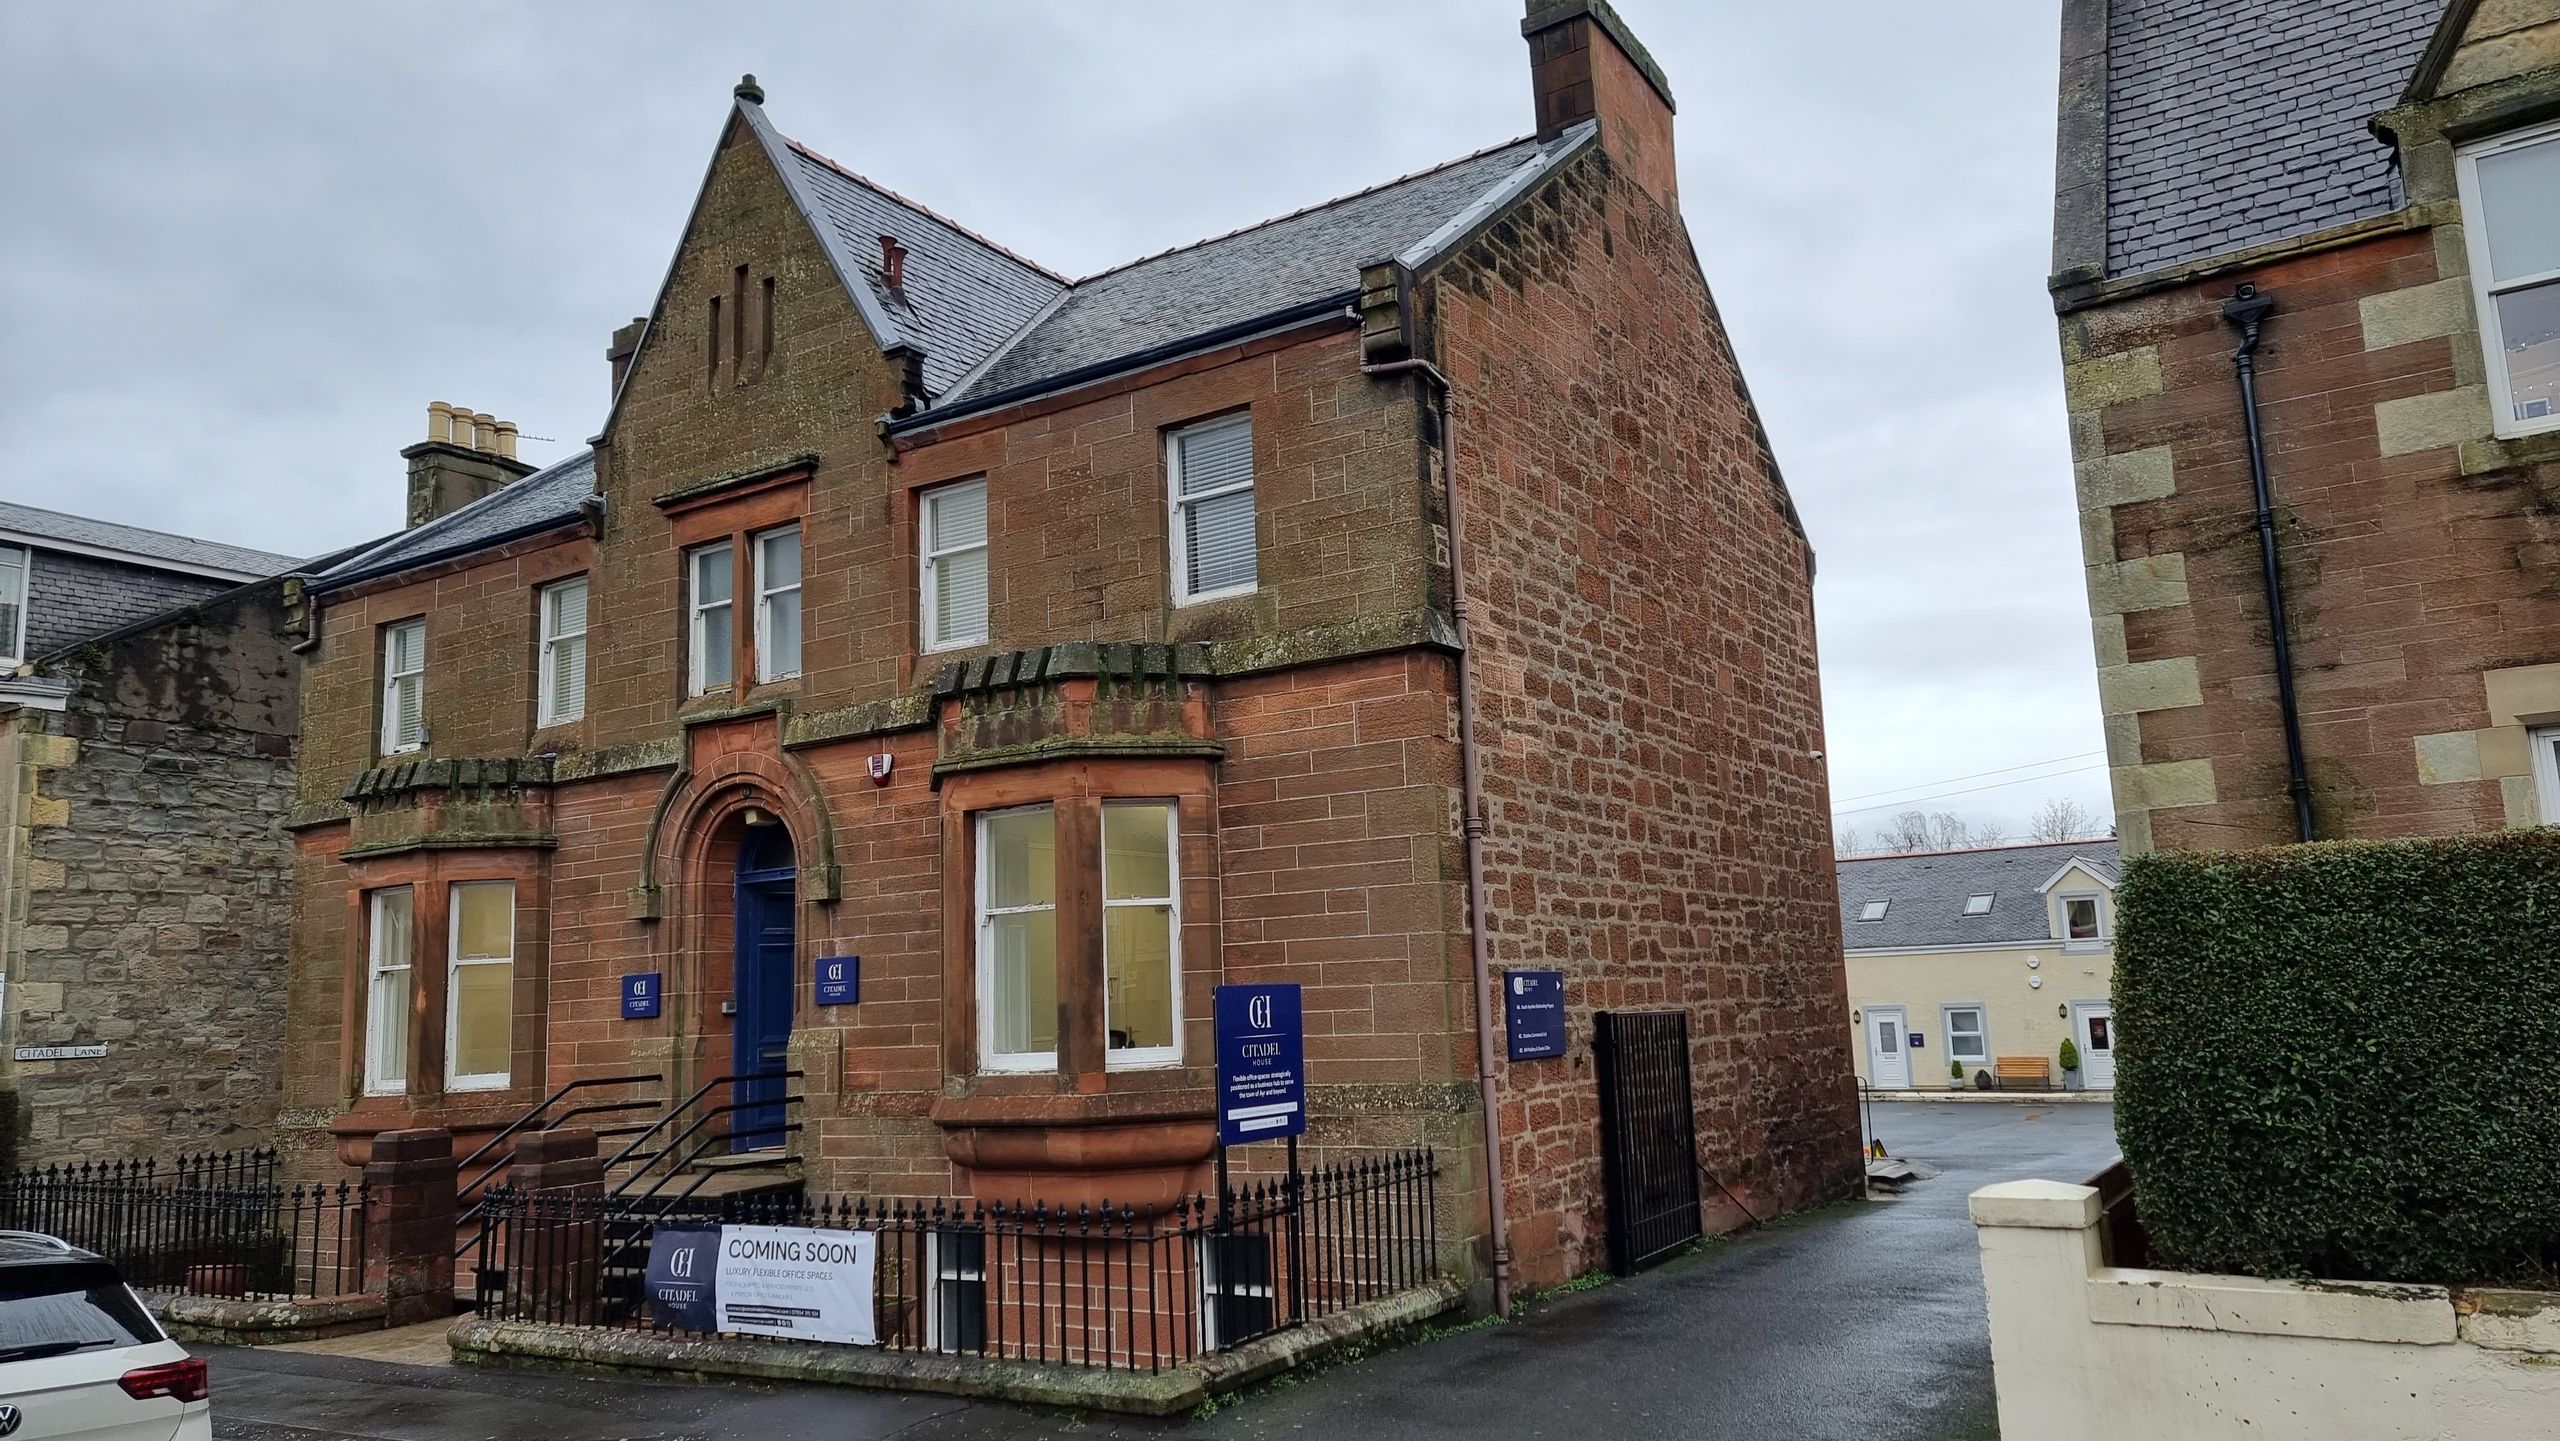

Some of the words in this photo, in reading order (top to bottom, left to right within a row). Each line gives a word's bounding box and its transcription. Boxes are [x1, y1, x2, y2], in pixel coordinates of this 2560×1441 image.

[19, 1048, 66, 1059] CITADEL
[74, 1047, 103, 1057] LANE
[1242, 1042, 1281, 1058] CITADEL
[1252, 1058, 1272, 1067] HOUSE
[728, 1239, 801, 1262] COMING
[805, 1241, 857, 1265] SOON
[725, 1267, 752, 1276] LUXURY
[752, 1268, 781, 1278] FLEXIBLE
[781, 1269, 806, 1279] OFFICE
[806, 1271, 833, 1281] SPACES
[658, 1288, 698, 1302] CITADEL
[668, 1302, 688, 1310] HOUSE
